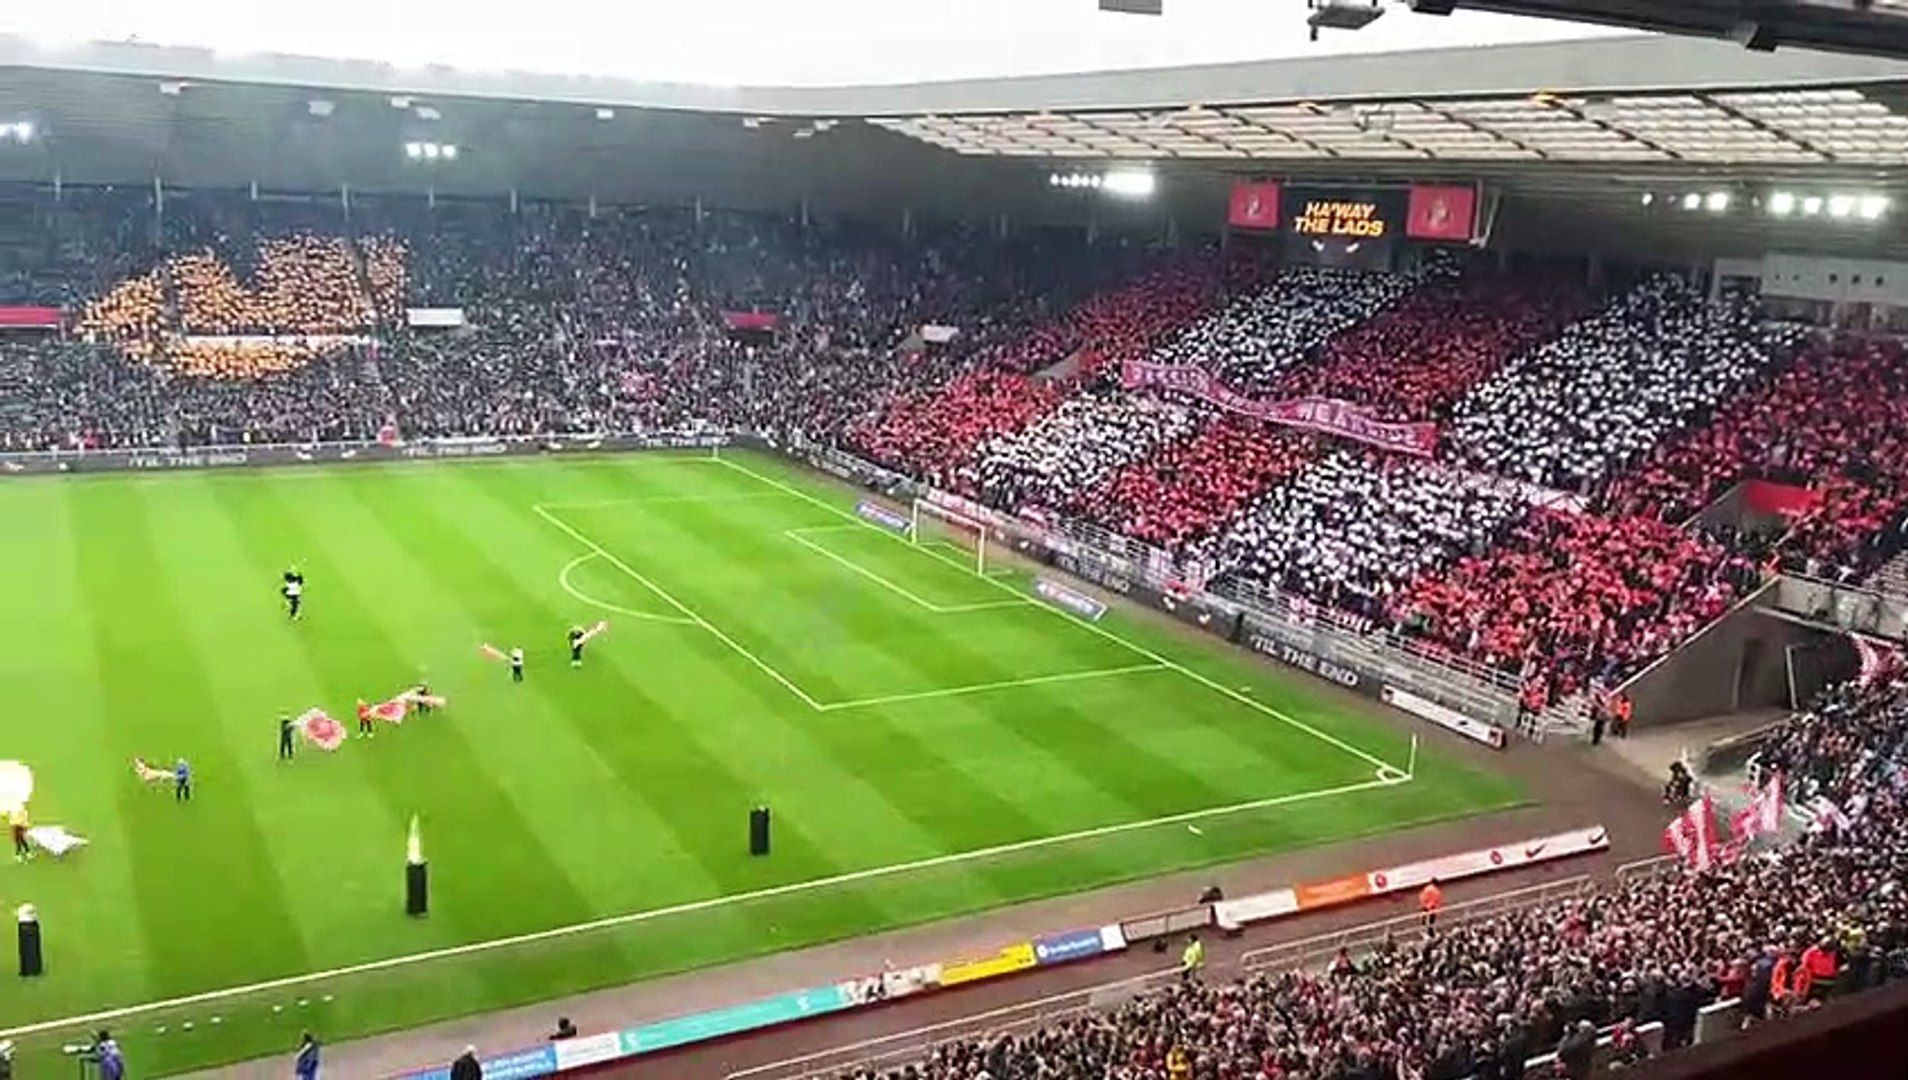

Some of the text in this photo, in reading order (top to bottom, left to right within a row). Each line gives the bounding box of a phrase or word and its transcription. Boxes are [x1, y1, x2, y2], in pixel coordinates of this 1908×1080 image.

[1305, 202, 1375, 219] HA'WAY
[1293, 216, 1384, 236] THE LADS
[1282, 646, 1314, 670] THE
[1319, 658, 1358, 686] END
